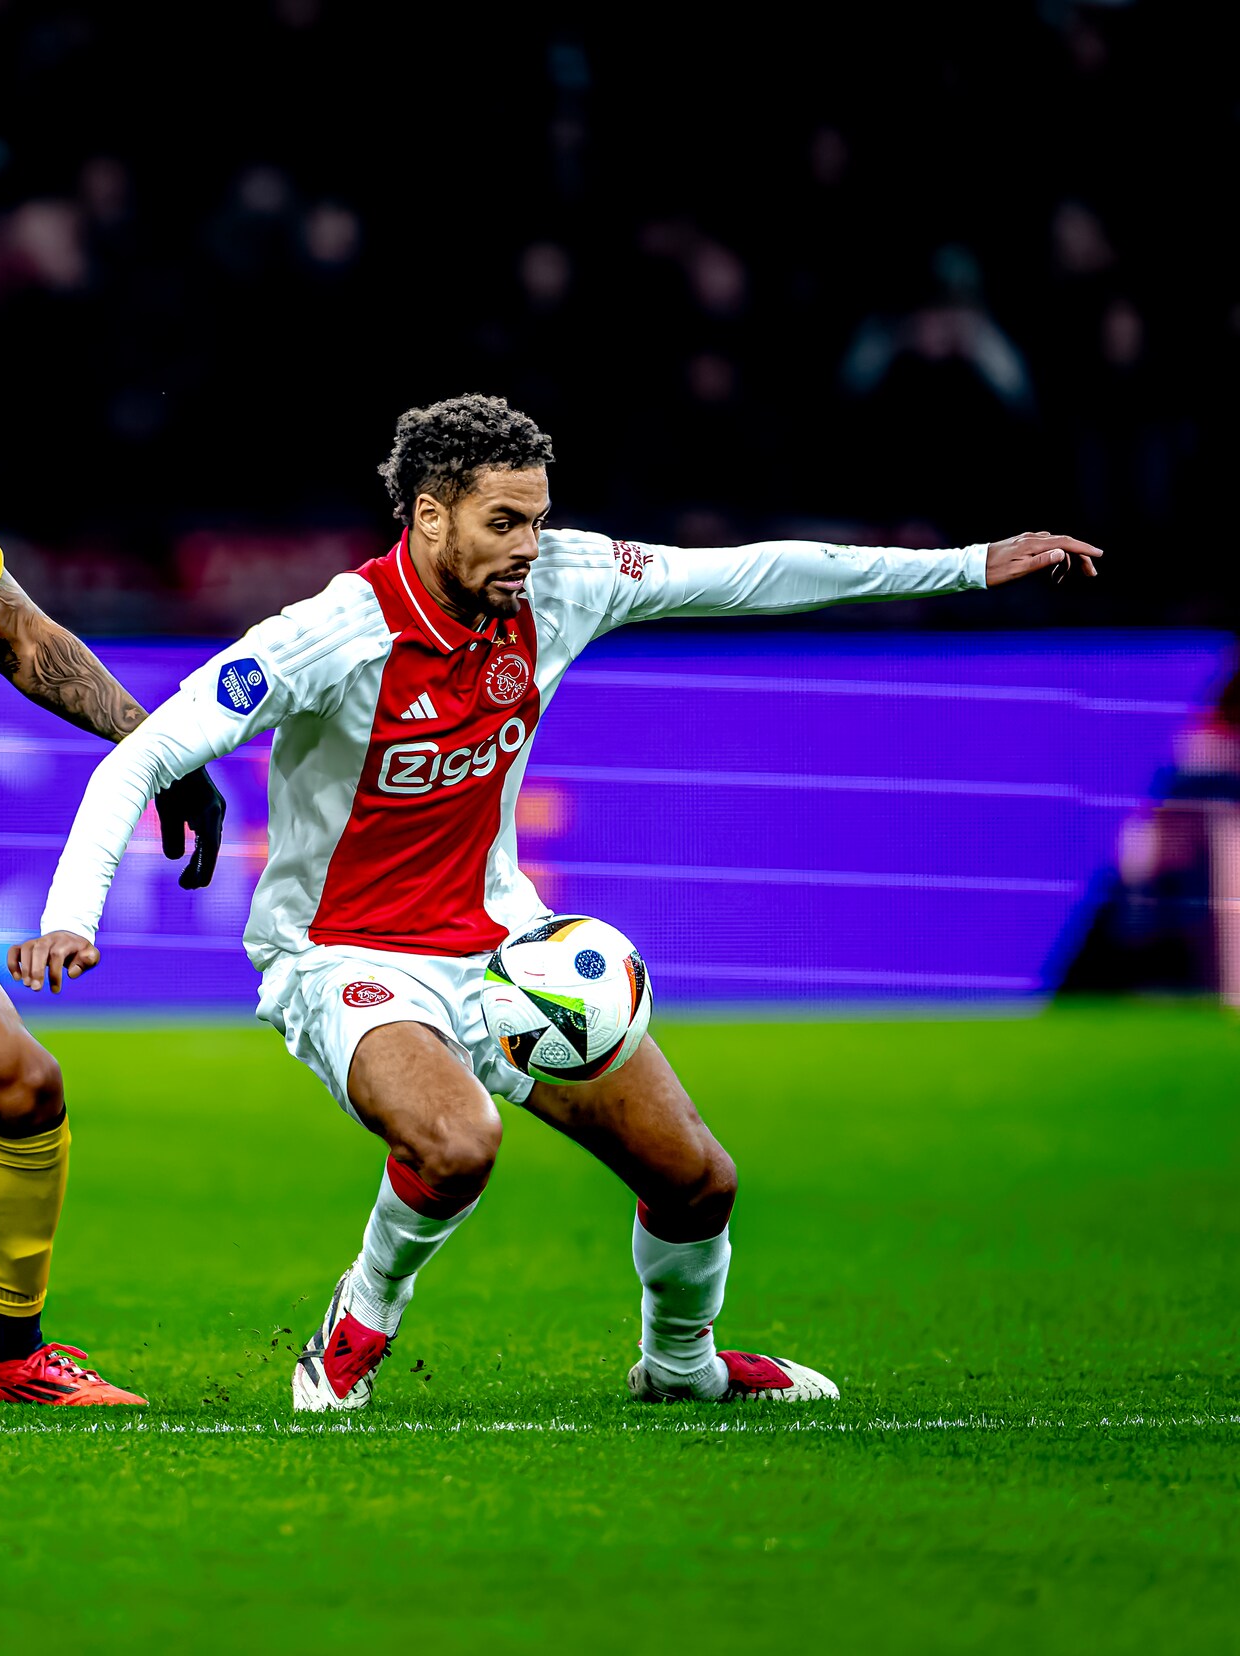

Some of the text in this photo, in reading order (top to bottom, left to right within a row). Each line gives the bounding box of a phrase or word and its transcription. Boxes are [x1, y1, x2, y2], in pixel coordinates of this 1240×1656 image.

[485, 655, 504, 685] AJAX
[221, 676, 242, 708] LOTERIJ
[226, 668, 251, 710] VRIENDEN
